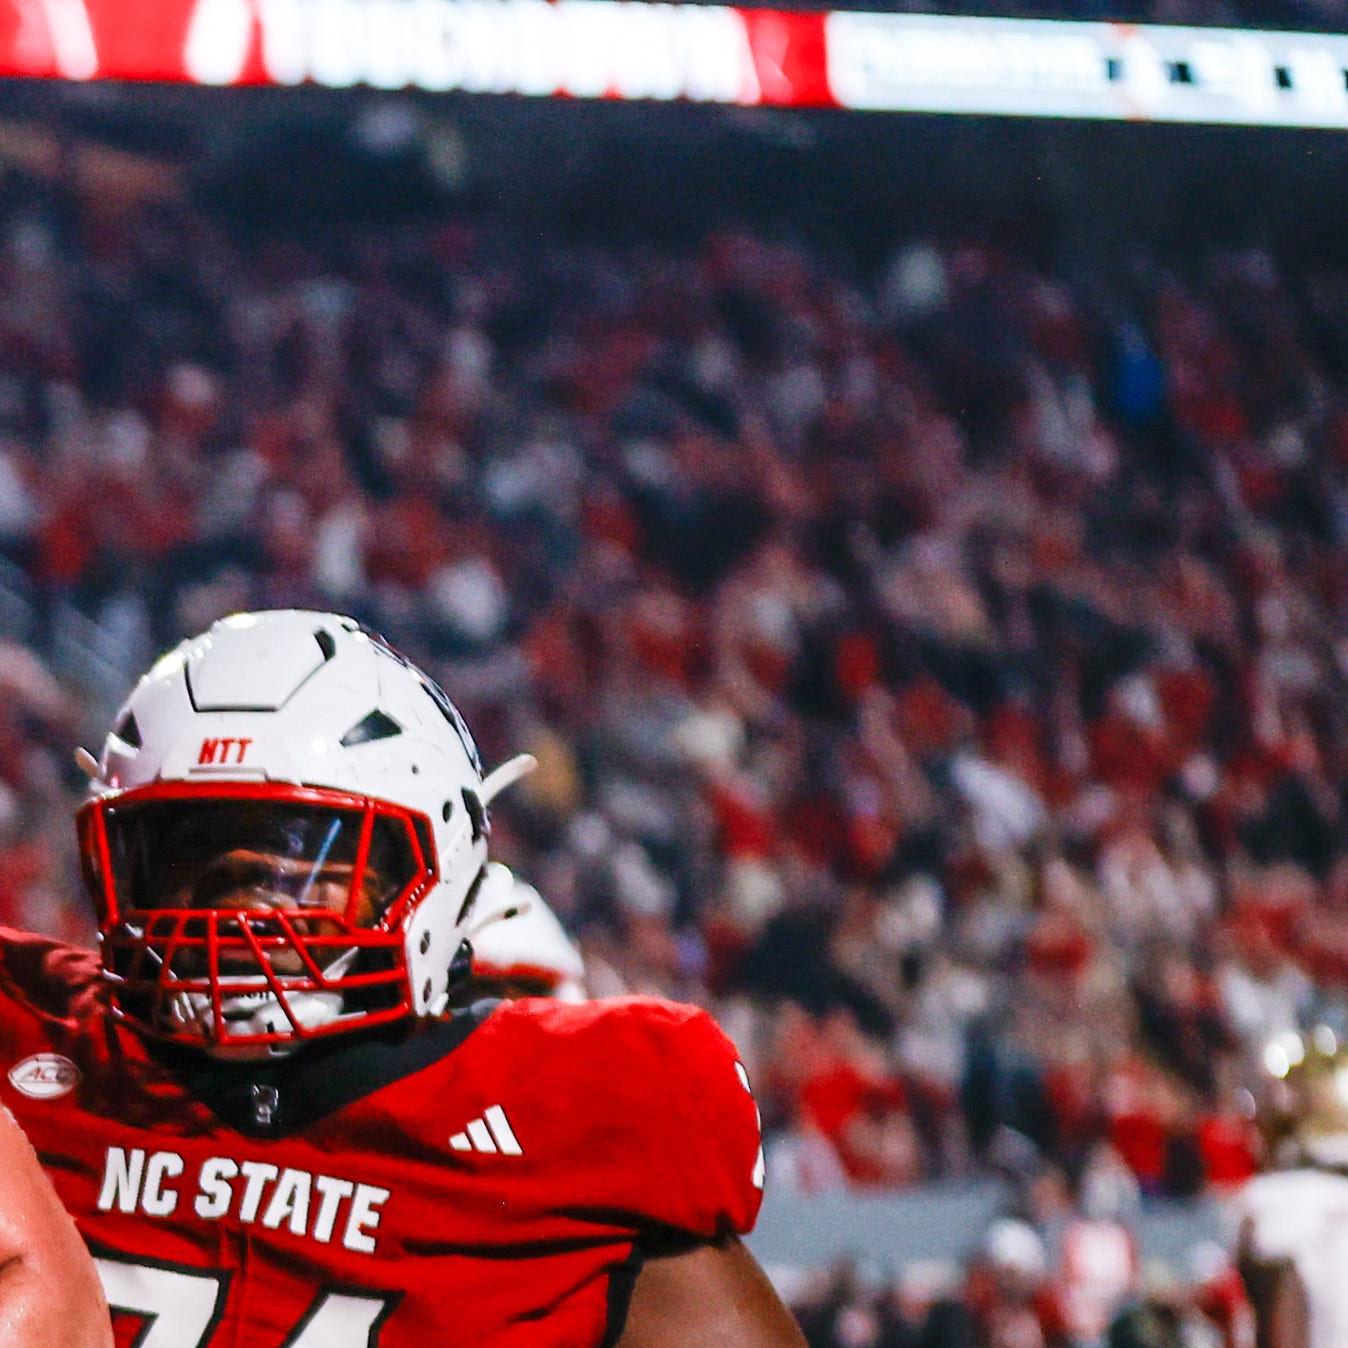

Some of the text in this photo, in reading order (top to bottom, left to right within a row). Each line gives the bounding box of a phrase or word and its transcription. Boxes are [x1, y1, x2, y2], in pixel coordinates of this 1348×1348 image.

[198, 737, 253, 764] HTT
[97, 1145, 392, 1255] NC STATE
